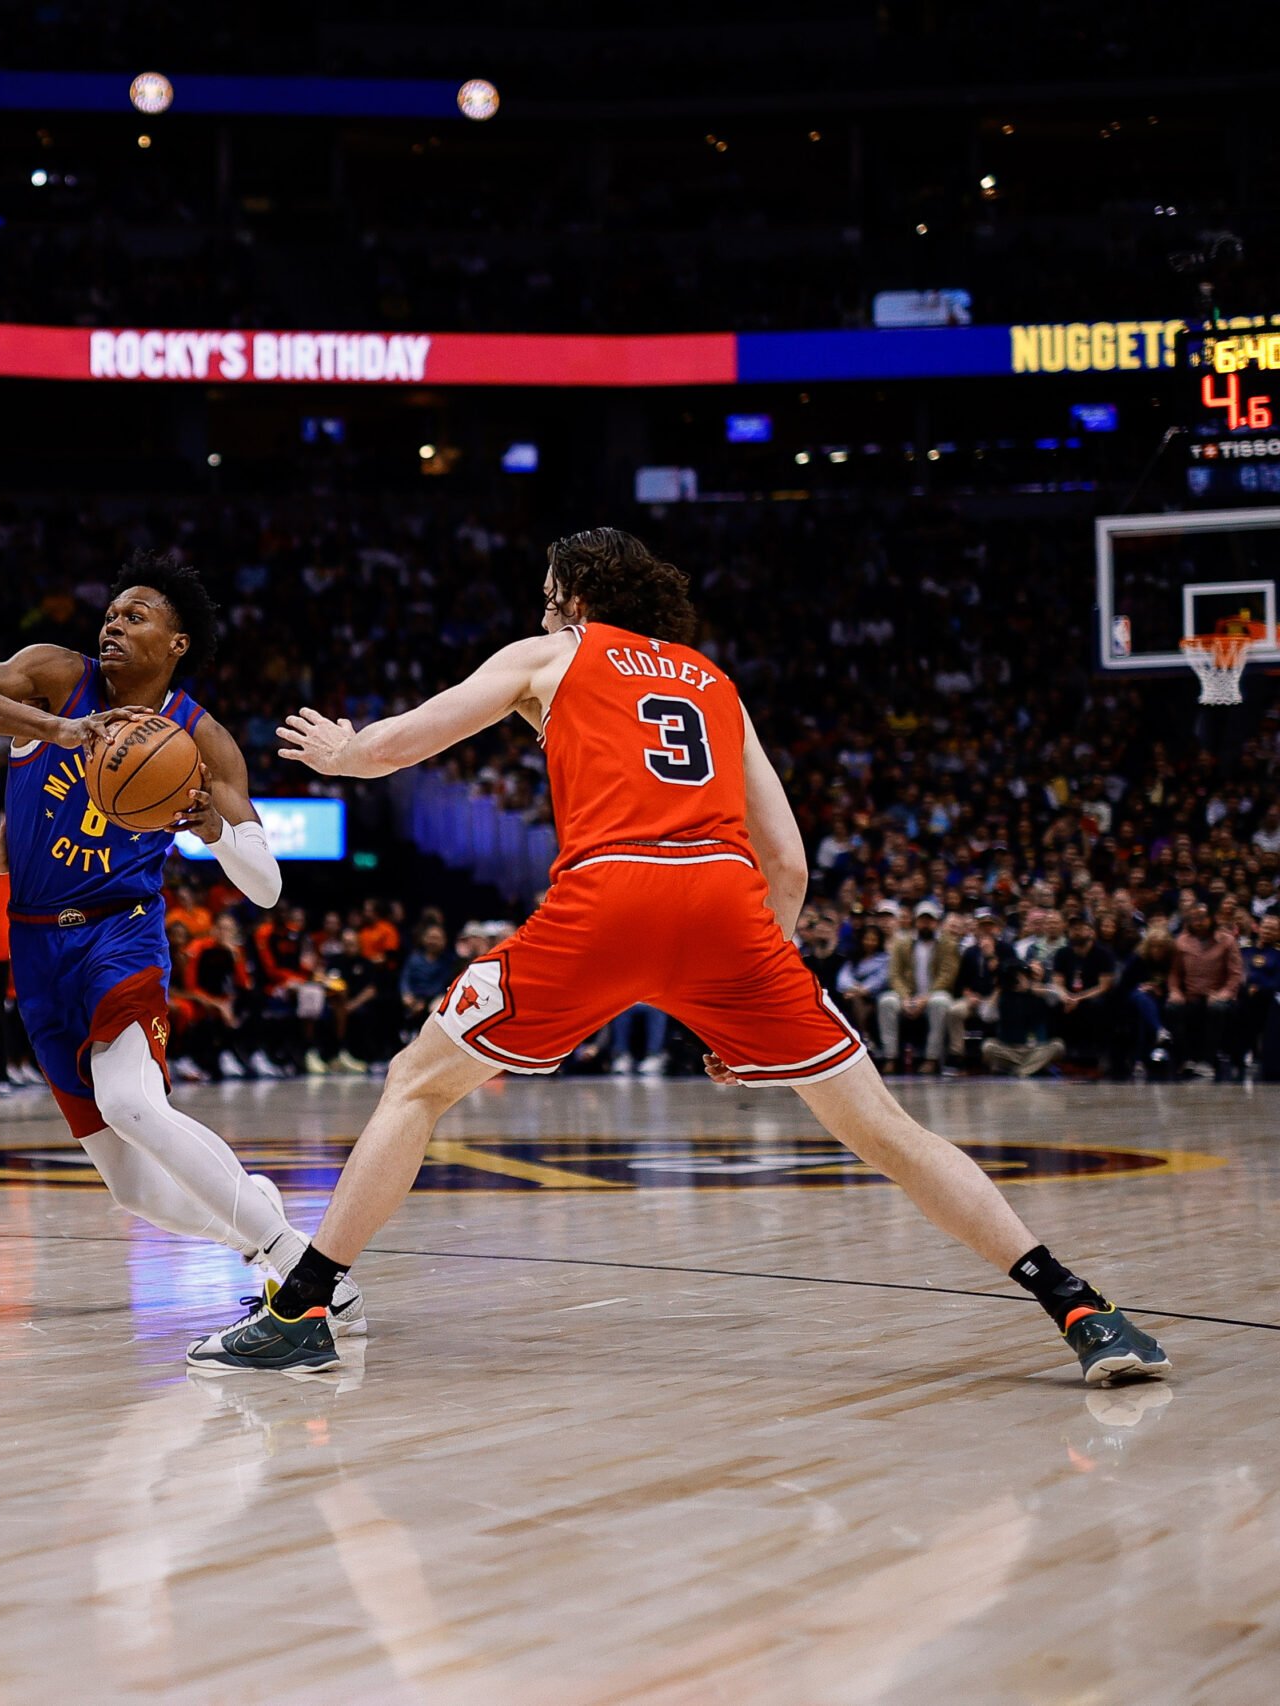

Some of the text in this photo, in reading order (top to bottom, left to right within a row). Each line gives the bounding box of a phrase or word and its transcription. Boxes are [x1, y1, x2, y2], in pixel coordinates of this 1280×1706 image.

[89, 331, 431, 381] ROCKY'S BIRTHDAY
[1202, 373, 1272, 430] 4.6
[606, 647, 717, 692] GIDDEY
[106, 718, 172, 772] Wilson
[637, 693, 715, 787] 3
[51, 836, 111, 873] CITY
